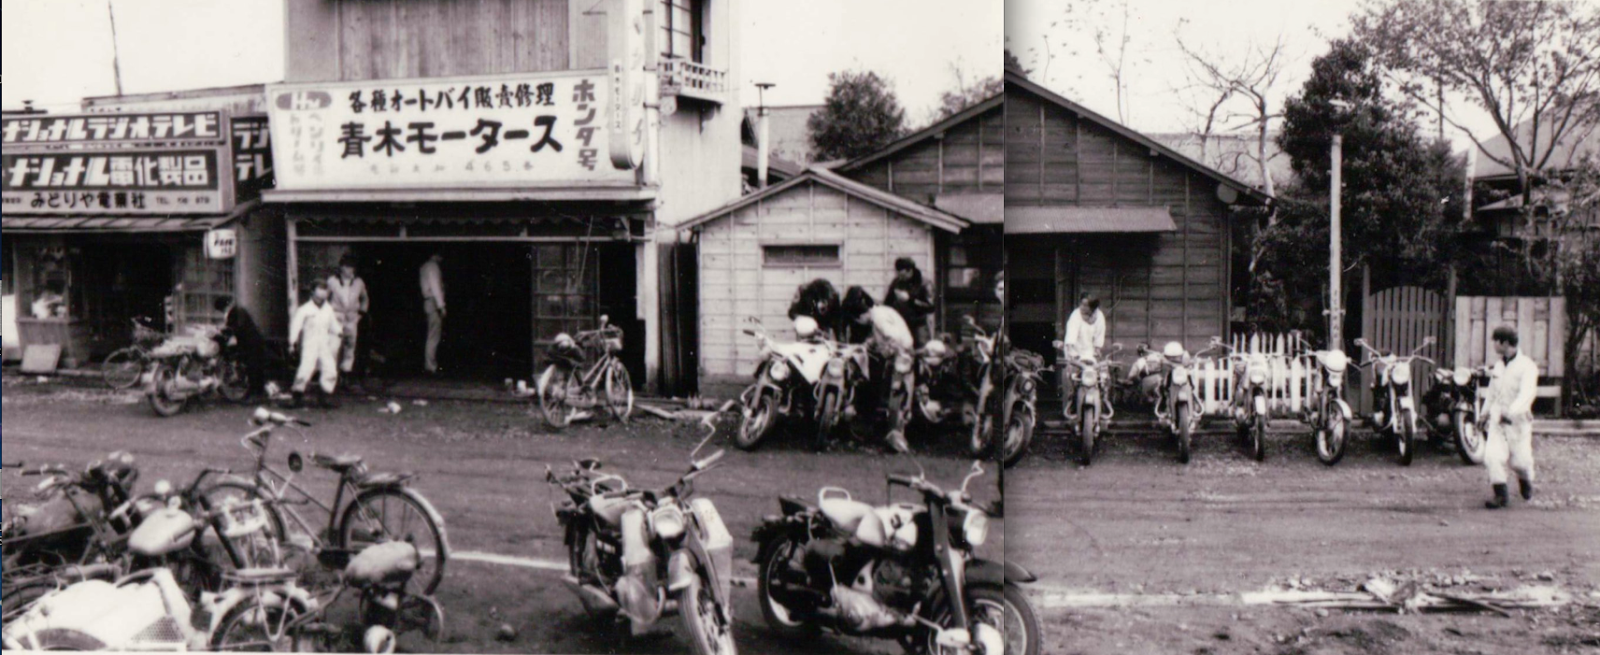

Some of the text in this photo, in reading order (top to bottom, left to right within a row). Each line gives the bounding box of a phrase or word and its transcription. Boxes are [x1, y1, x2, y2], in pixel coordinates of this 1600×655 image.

[3, 113, 217, 142] ナショナルラジオテレビ
[338, 115, 563, 159] 青木モータース
[572, 79, 600, 171] ホンダ号
[8, 155, 209, 187] ナショナル電化製品
[235, 153, 272, 182] テレ
